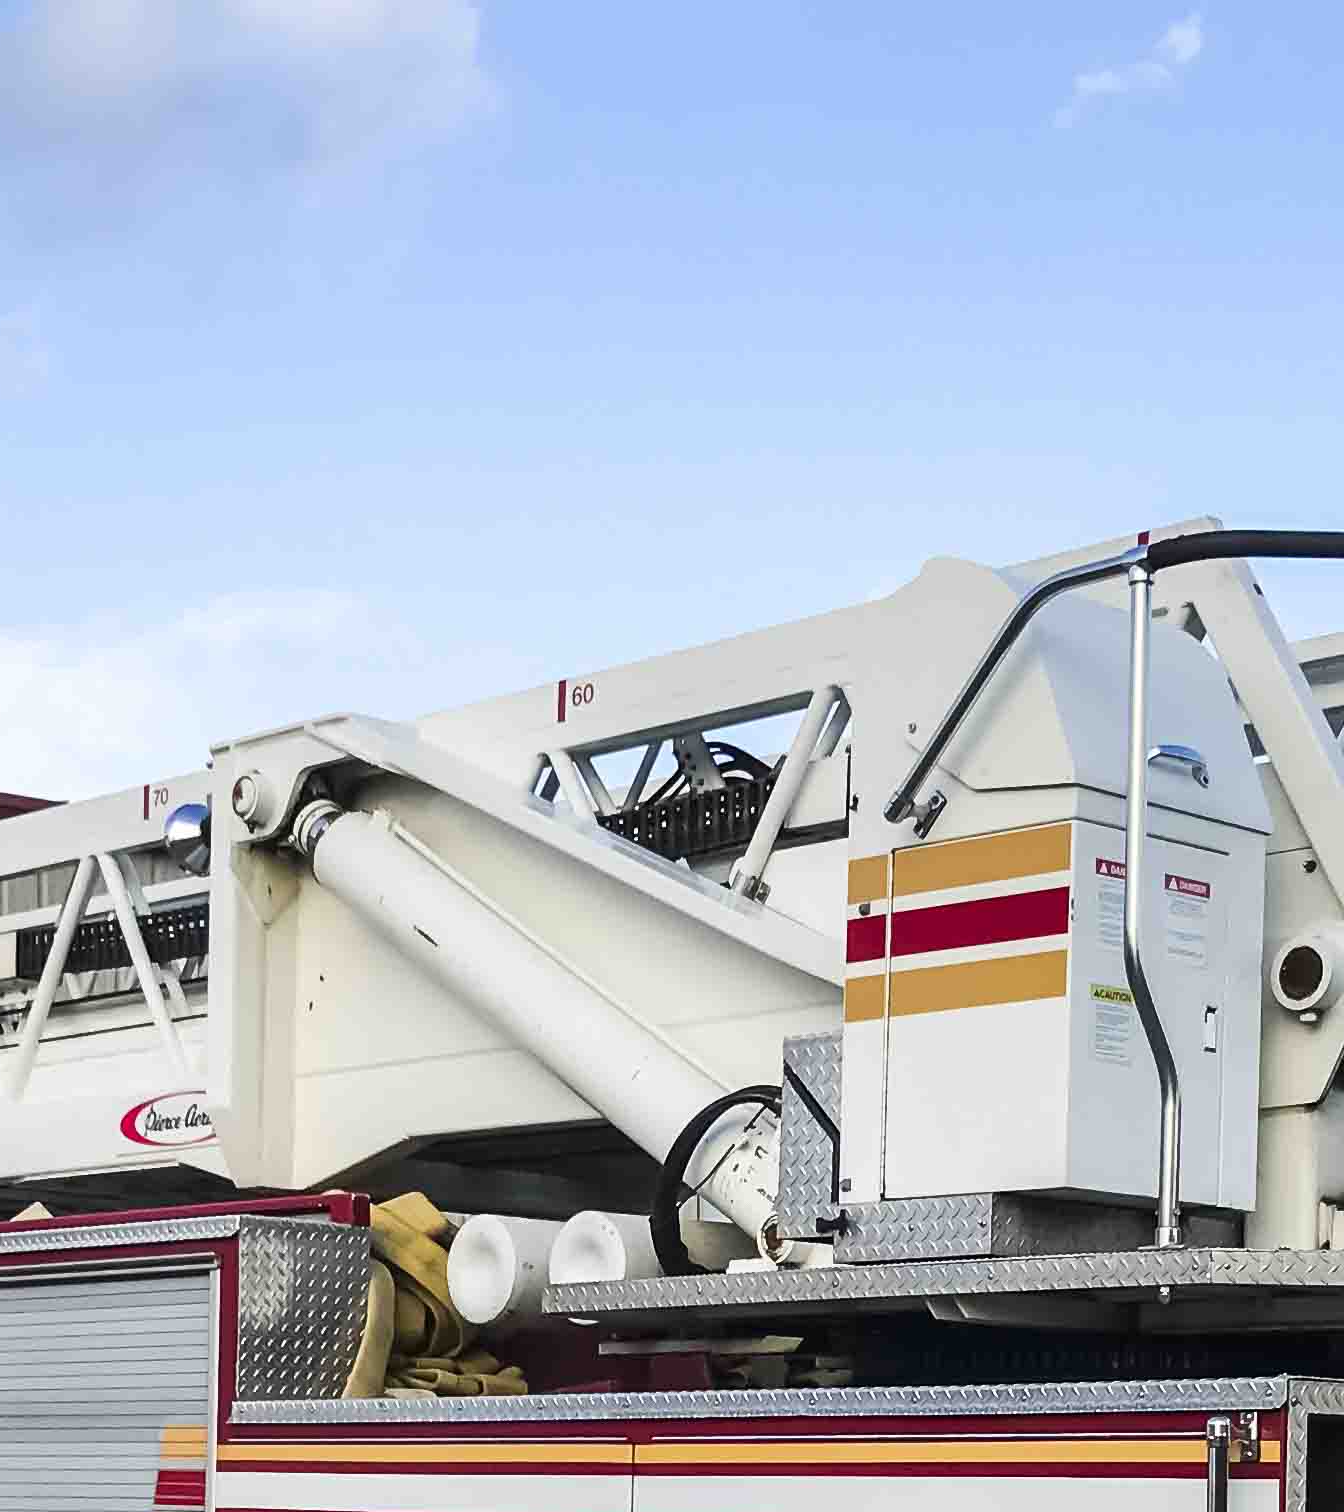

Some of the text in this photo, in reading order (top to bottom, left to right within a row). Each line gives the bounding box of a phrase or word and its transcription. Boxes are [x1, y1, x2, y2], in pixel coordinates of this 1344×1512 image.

[572, 683, 594, 706] 60
[154, 787, 169, 807] 70
[144, 1104, 182, 1136] Pierce
